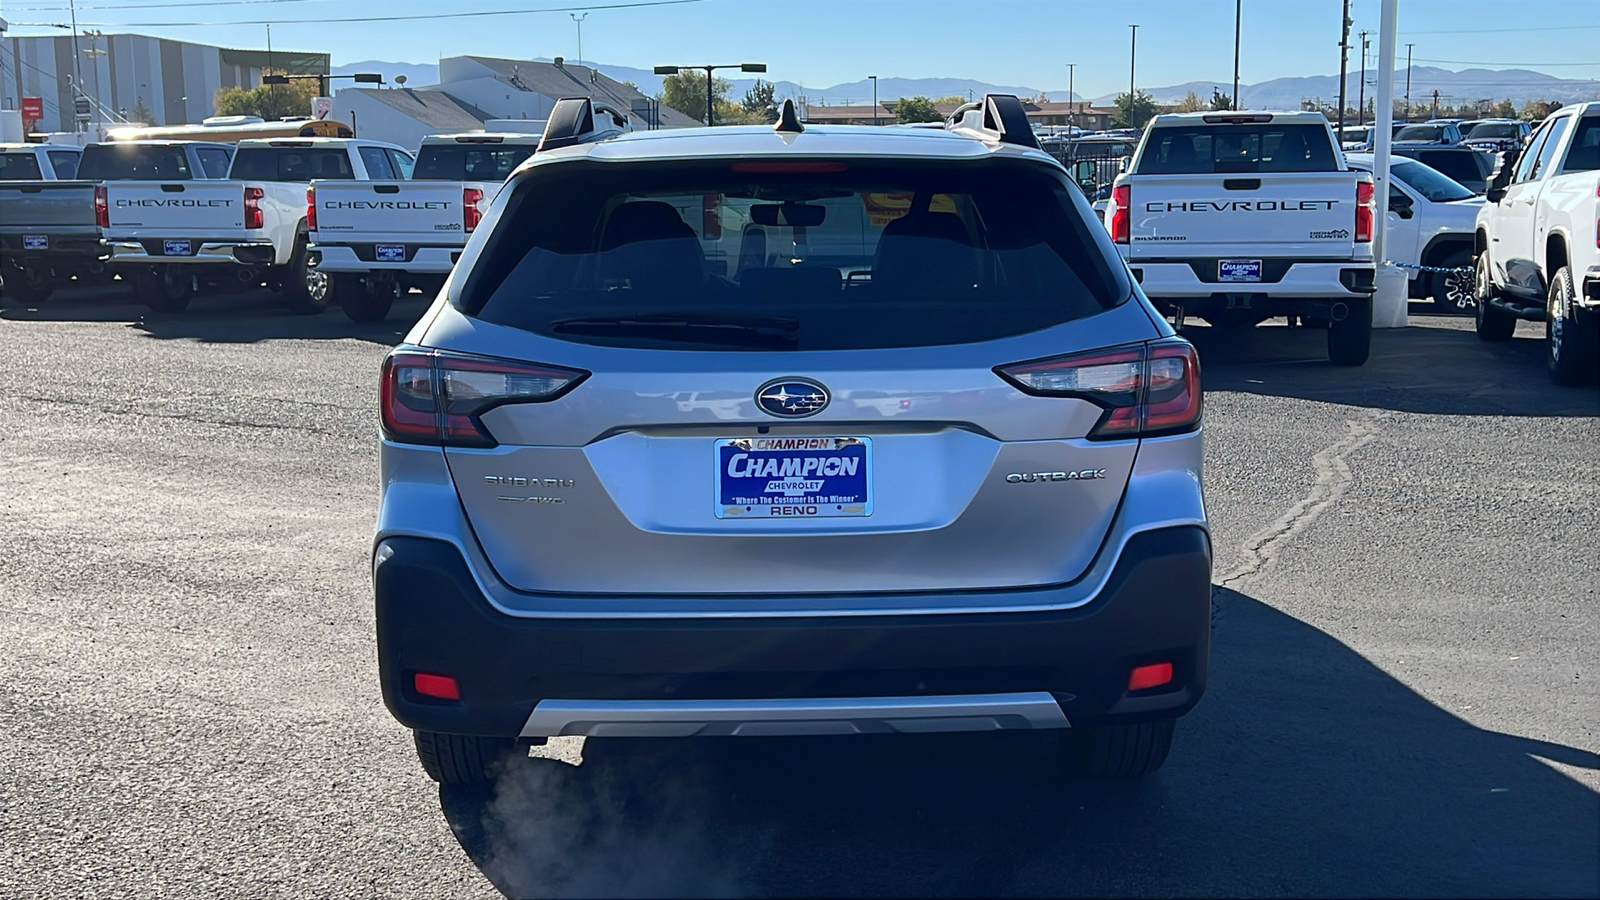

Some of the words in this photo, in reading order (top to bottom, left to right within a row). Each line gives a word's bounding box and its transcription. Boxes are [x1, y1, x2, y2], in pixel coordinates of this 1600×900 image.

[116, 199, 234, 208] CHEVROLET
[325, 201, 452, 210] CHEVROLET
[1146, 200, 1339, 212] CHEVROLET
[1221, 262, 1259, 271] CHAMPION
[757, 439, 830, 450] CHAMPION
[727, 453, 859, 478] CHAMPION
[1005, 468, 1106, 484] OUTBACK
[484, 475, 575, 488] SUBARU
[768, 482, 820, 490] CHEVROLET
[759, 496, 772, 504] The
[773, 496, 807, 504] Customer
[816, 496, 829, 504] The
[770, 506, 818, 516] RENO
